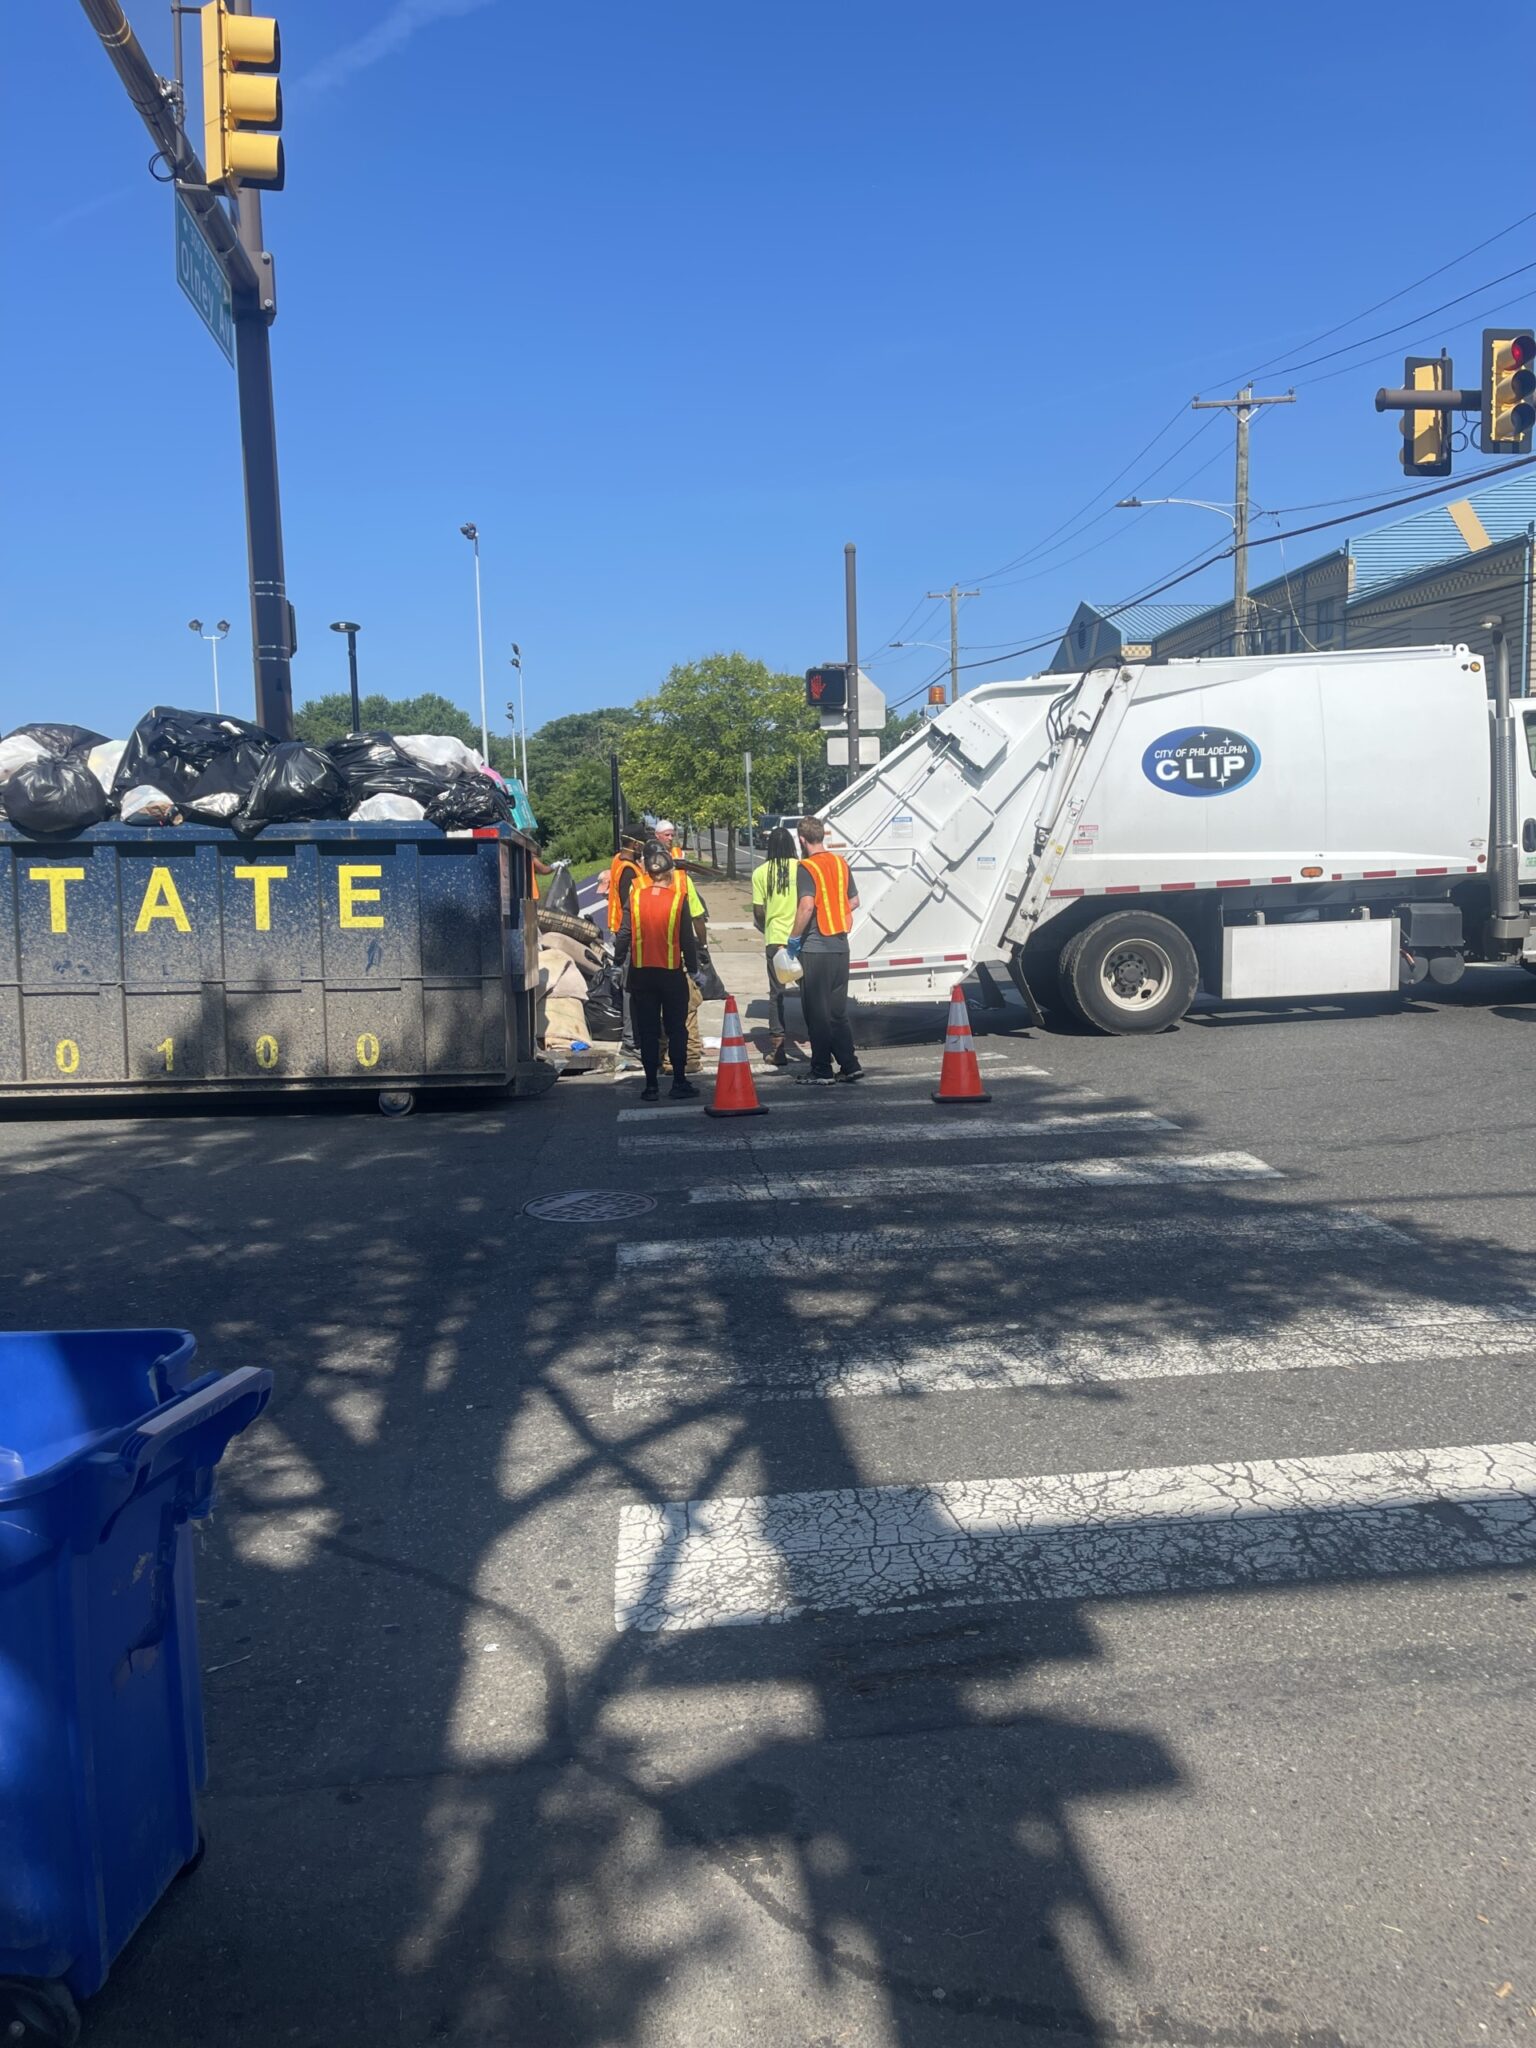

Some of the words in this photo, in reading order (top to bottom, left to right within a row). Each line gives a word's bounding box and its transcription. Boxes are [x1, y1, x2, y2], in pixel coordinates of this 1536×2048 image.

[203, 247, 209, 274] E
[180, 240, 214, 325] Olney
[1154, 749, 1174, 759] CITY
[1175, 748, 1187, 758] OF
[1188, 745, 1248, 757] PHILADELPHIA
[1156, 756, 1245, 781] CLIP
